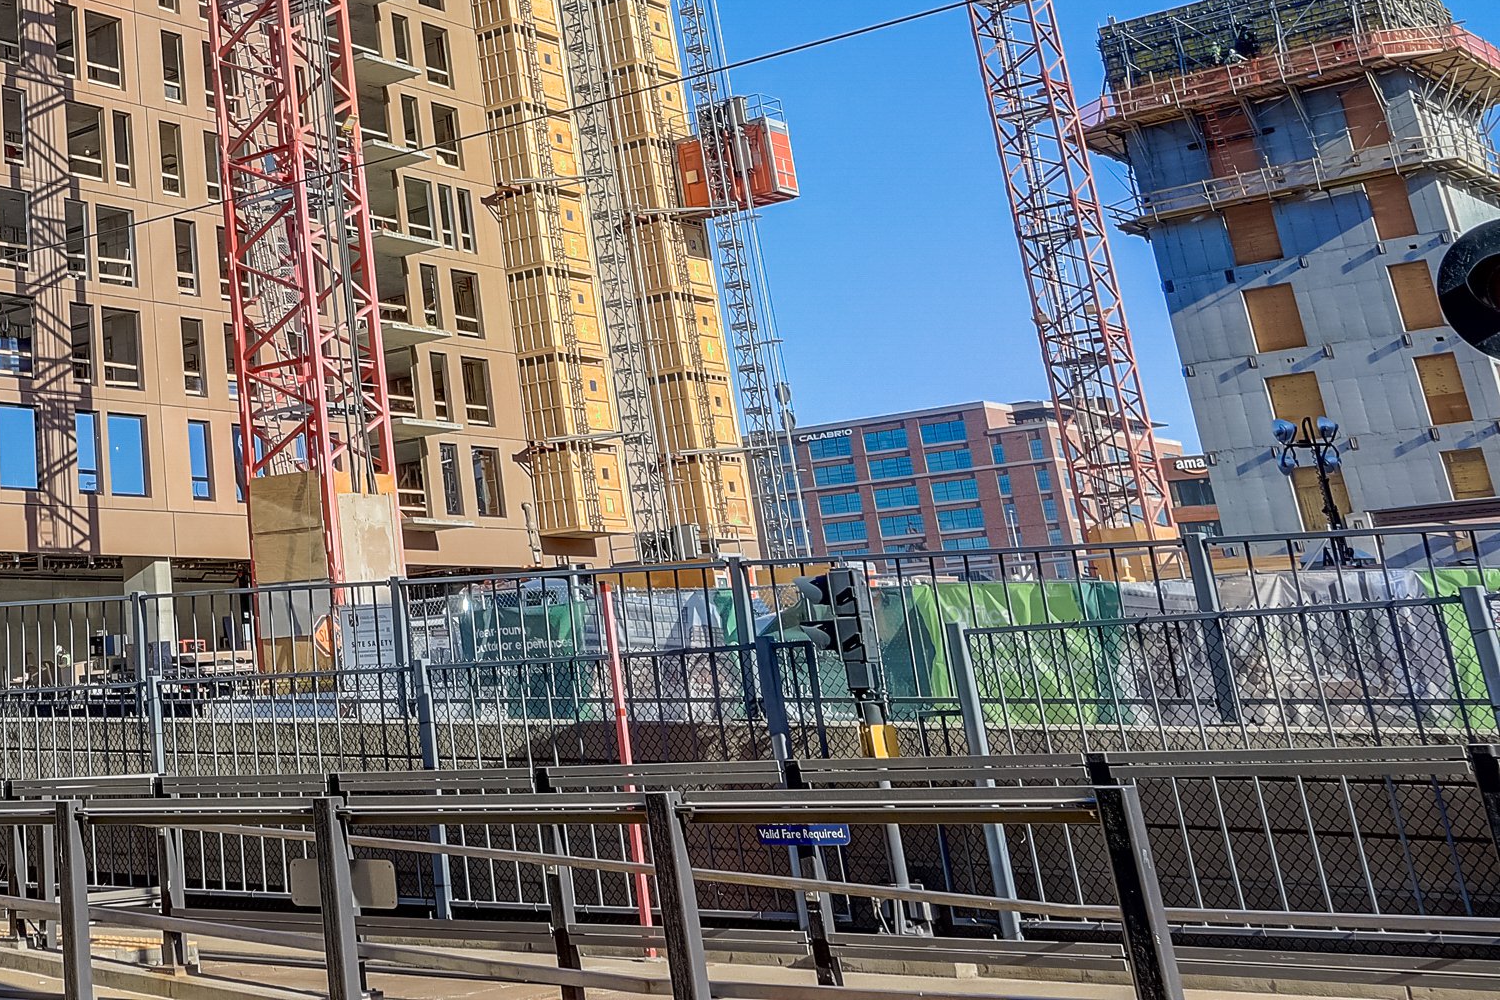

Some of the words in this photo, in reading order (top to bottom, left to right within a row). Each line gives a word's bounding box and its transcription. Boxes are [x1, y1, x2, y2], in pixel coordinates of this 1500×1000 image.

[799, 428, 853, 442] CALABRIO
[1175, 458, 1207, 470] ama
[475, 626, 527, 639] Year-roun
[367, 640, 393, 648] SAETY
[515, 638, 573, 651] eperinces
[759, 828, 781, 839] Valid
[781, 829, 801, 839] Fare
[802, 827, 847, 842] Required.
